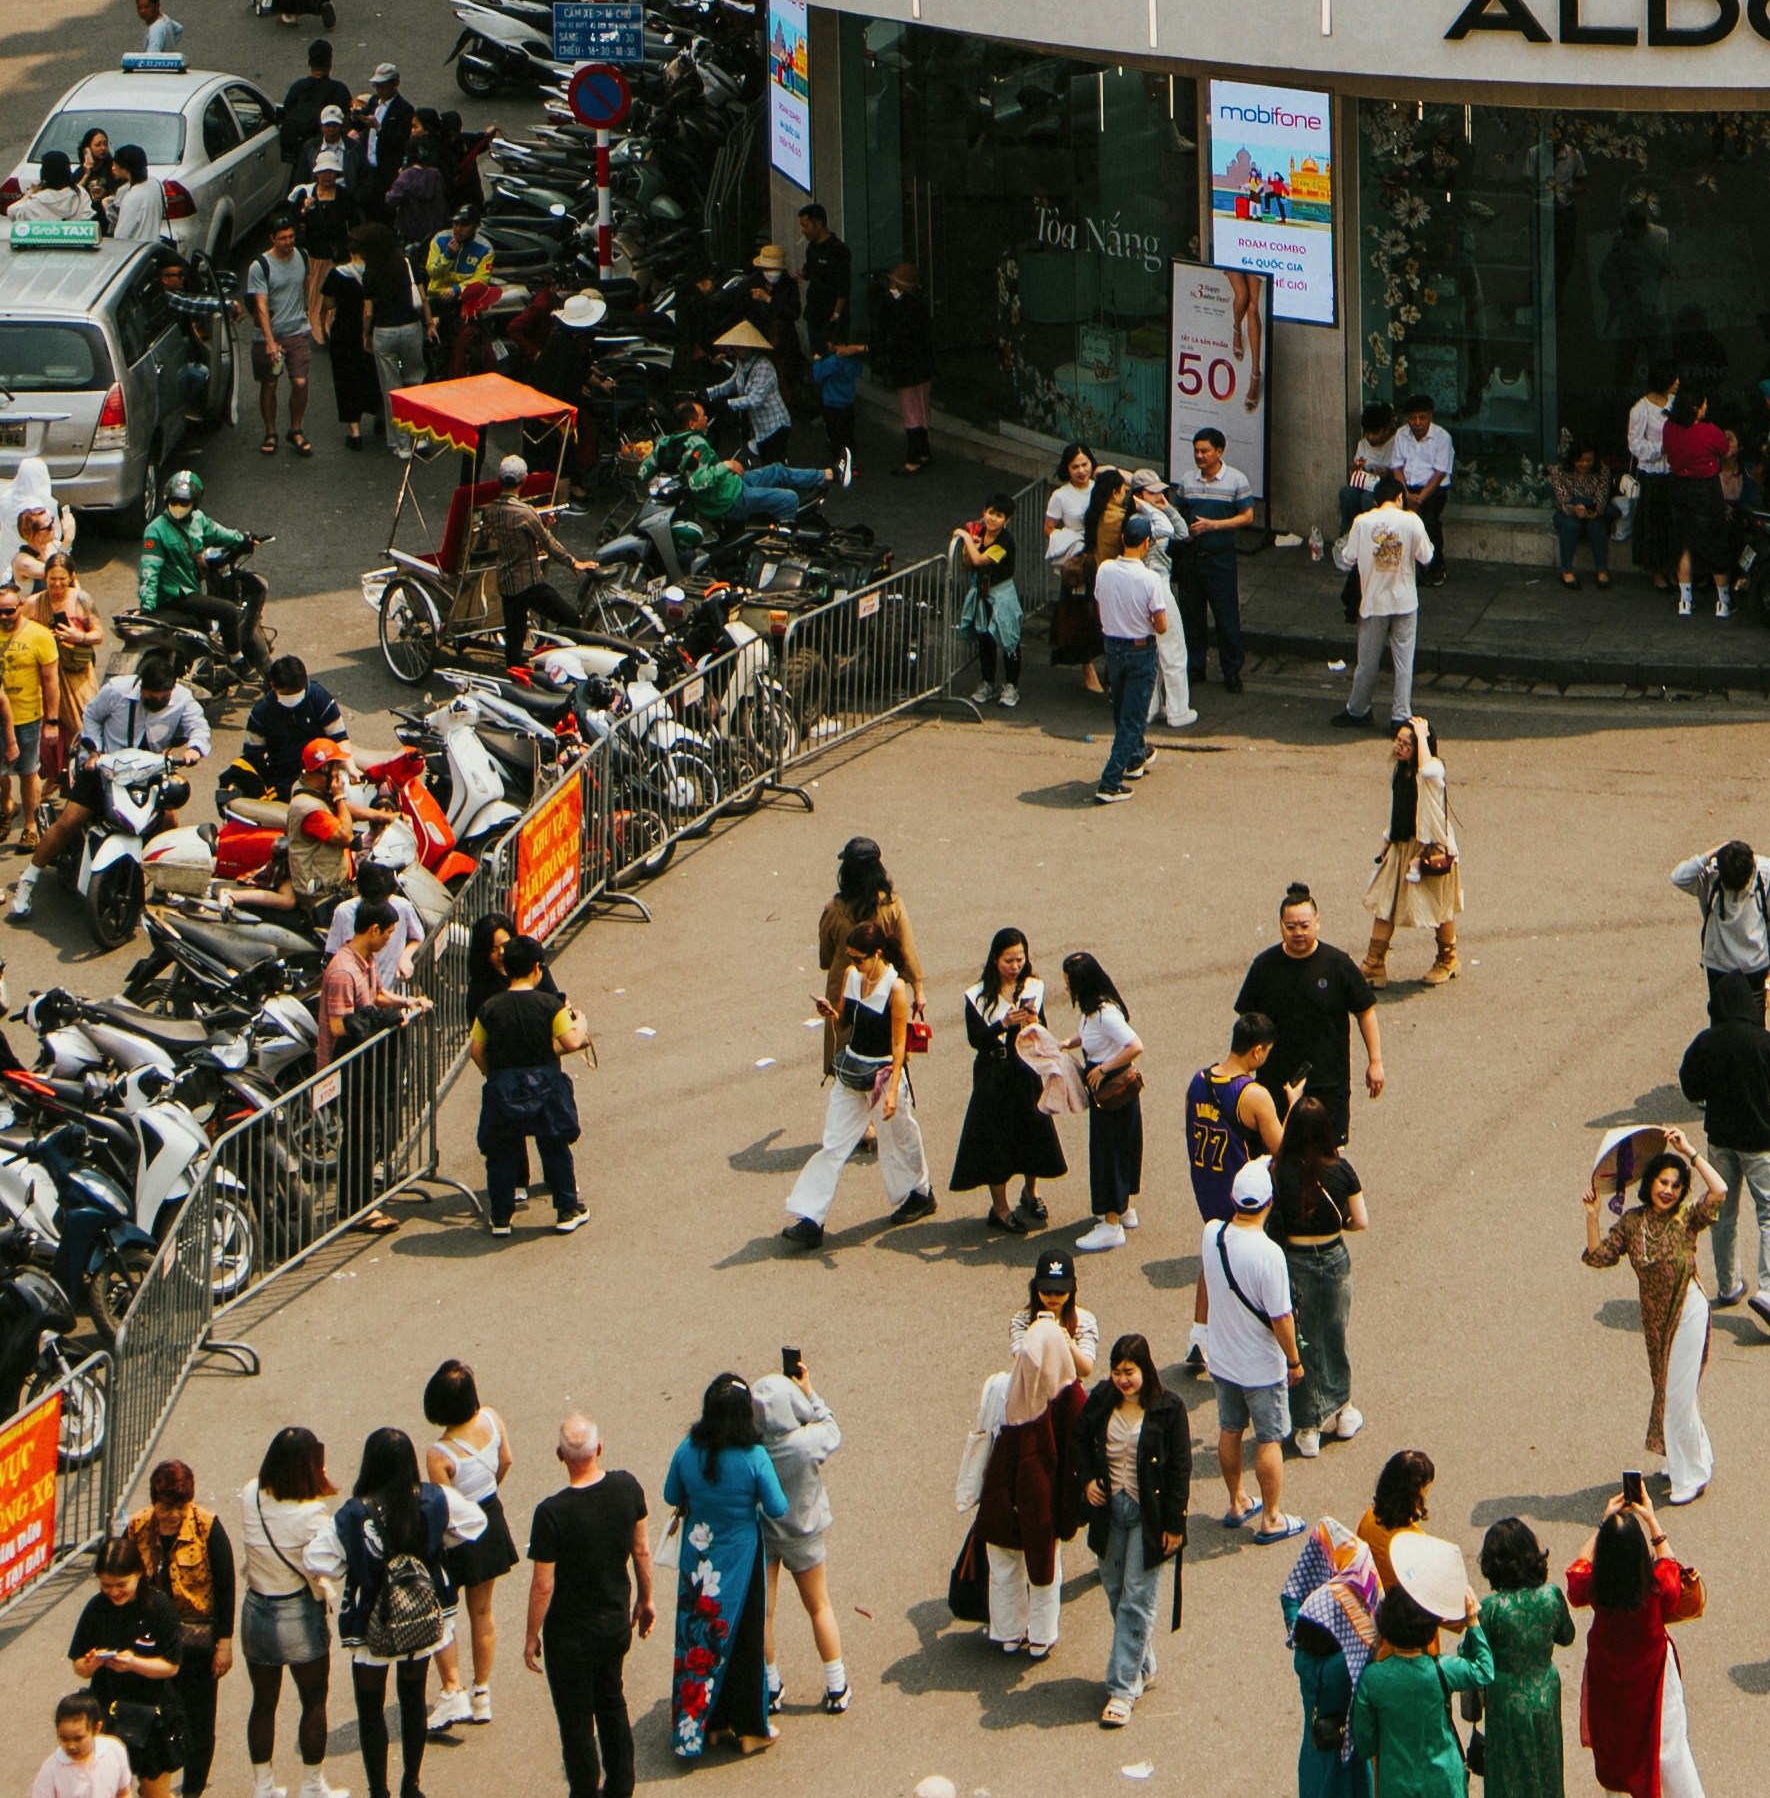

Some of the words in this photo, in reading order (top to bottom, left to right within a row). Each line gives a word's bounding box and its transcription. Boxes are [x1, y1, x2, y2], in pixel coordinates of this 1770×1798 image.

[1220, 104, 1322, 130] mobifone
[32, 224, 60, 236] Grab
[62, 225, 95, 237] TAXI
[1085, 210, 1162, 273] Nắng
[1238, 237, 1267, 250] ROAM
[1270, 241, 1307, 255] COMBO
[1242, 257, 1254, 266] 64
[1287, 262, 1304, 273] GIA
[1177, 351, 1236, 403] 50
[1194, 1122, 1229, 1172] 77
[31, 1469, 57, 1512] XE
